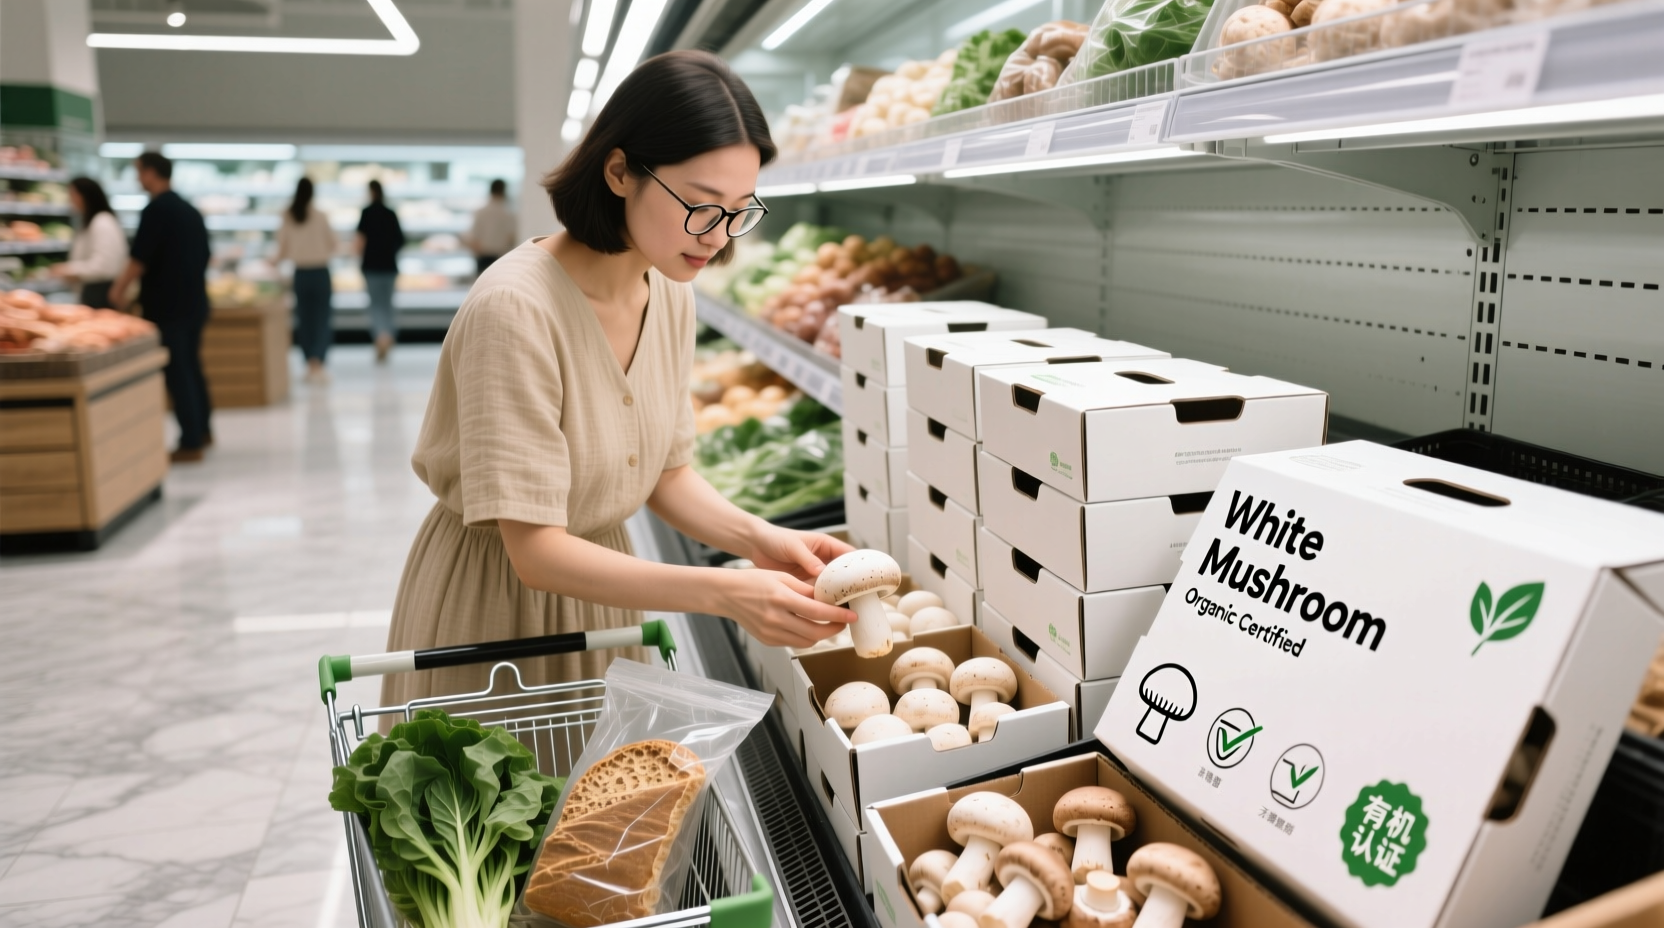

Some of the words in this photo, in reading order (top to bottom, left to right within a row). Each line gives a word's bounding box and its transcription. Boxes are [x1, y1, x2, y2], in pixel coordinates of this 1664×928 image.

[1225, 490, 1324, 561] White
[1185, 587, 1238, 625] Organic
[1239, 613, 1307, 658] Certified
[1198, 538, 1387, 652] Mushroom
[1350, 824, 1406, 878] 认证
[1362, 794, 1416, 846] 有机
